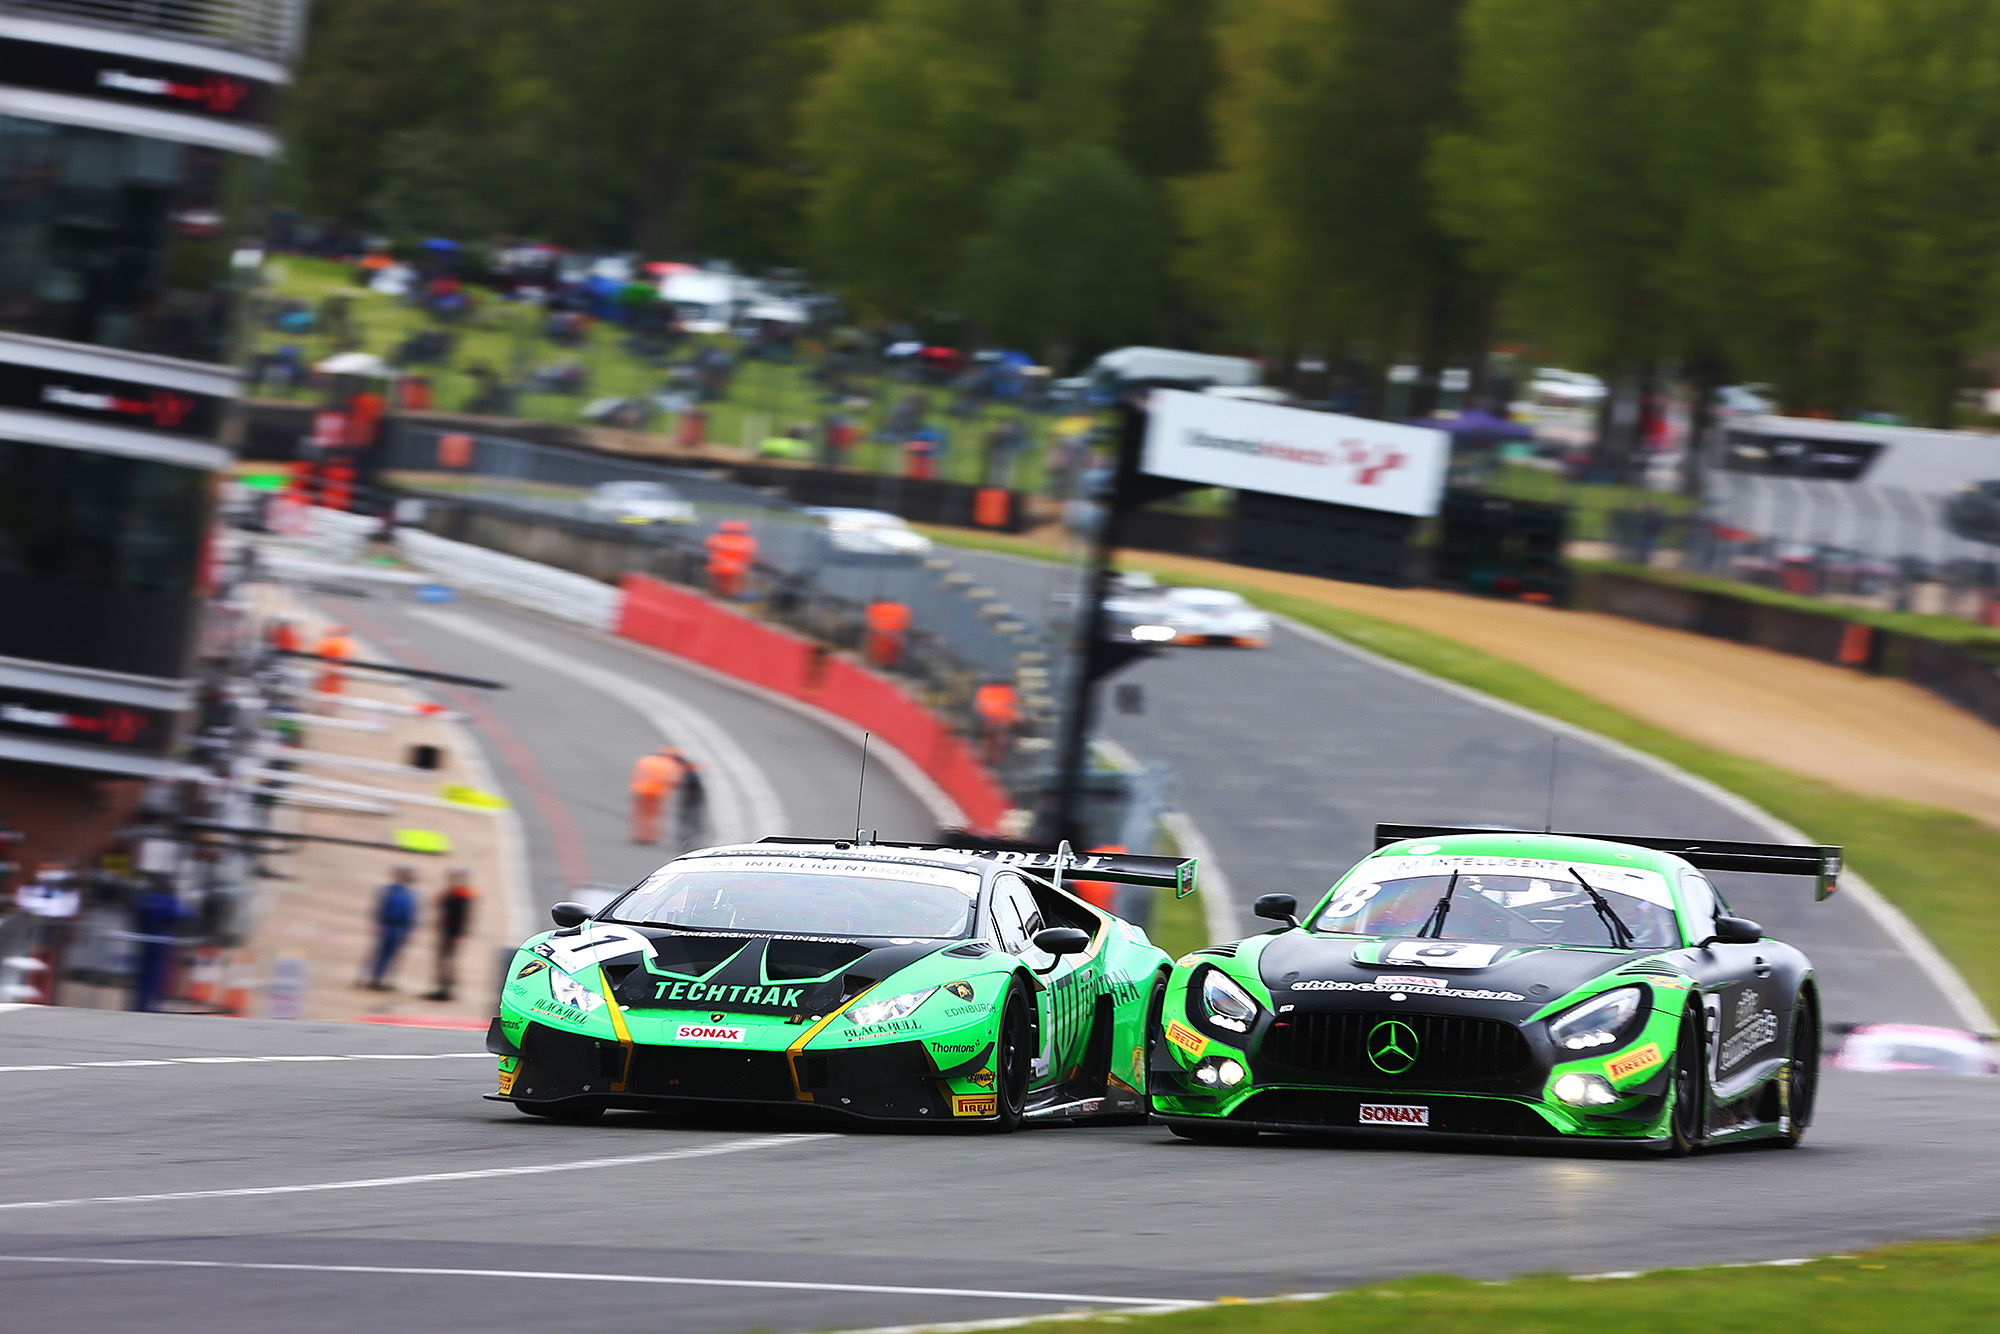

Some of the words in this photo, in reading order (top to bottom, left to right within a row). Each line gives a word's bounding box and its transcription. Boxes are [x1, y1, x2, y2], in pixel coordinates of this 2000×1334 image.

[1324, 883, 1383, 918] 8
[773, 933, 859, 945] EDINBURGH
[654, 981, 804, 1008] TECHTRAK
[944, 1003, 996, 1018] EDINBURGH
[679, 1027, 739, 1040] SONAX
[1168, 1023, 1203, 1053] PIRELLI
[931, 1042, 975, 1053] Thorntons
[1610, 1048, 1658, 1076] PIRELLI
[957, 1098, 995, 1113] PIRELLI
[1362, 1105, 1425, 1124] SONAX
